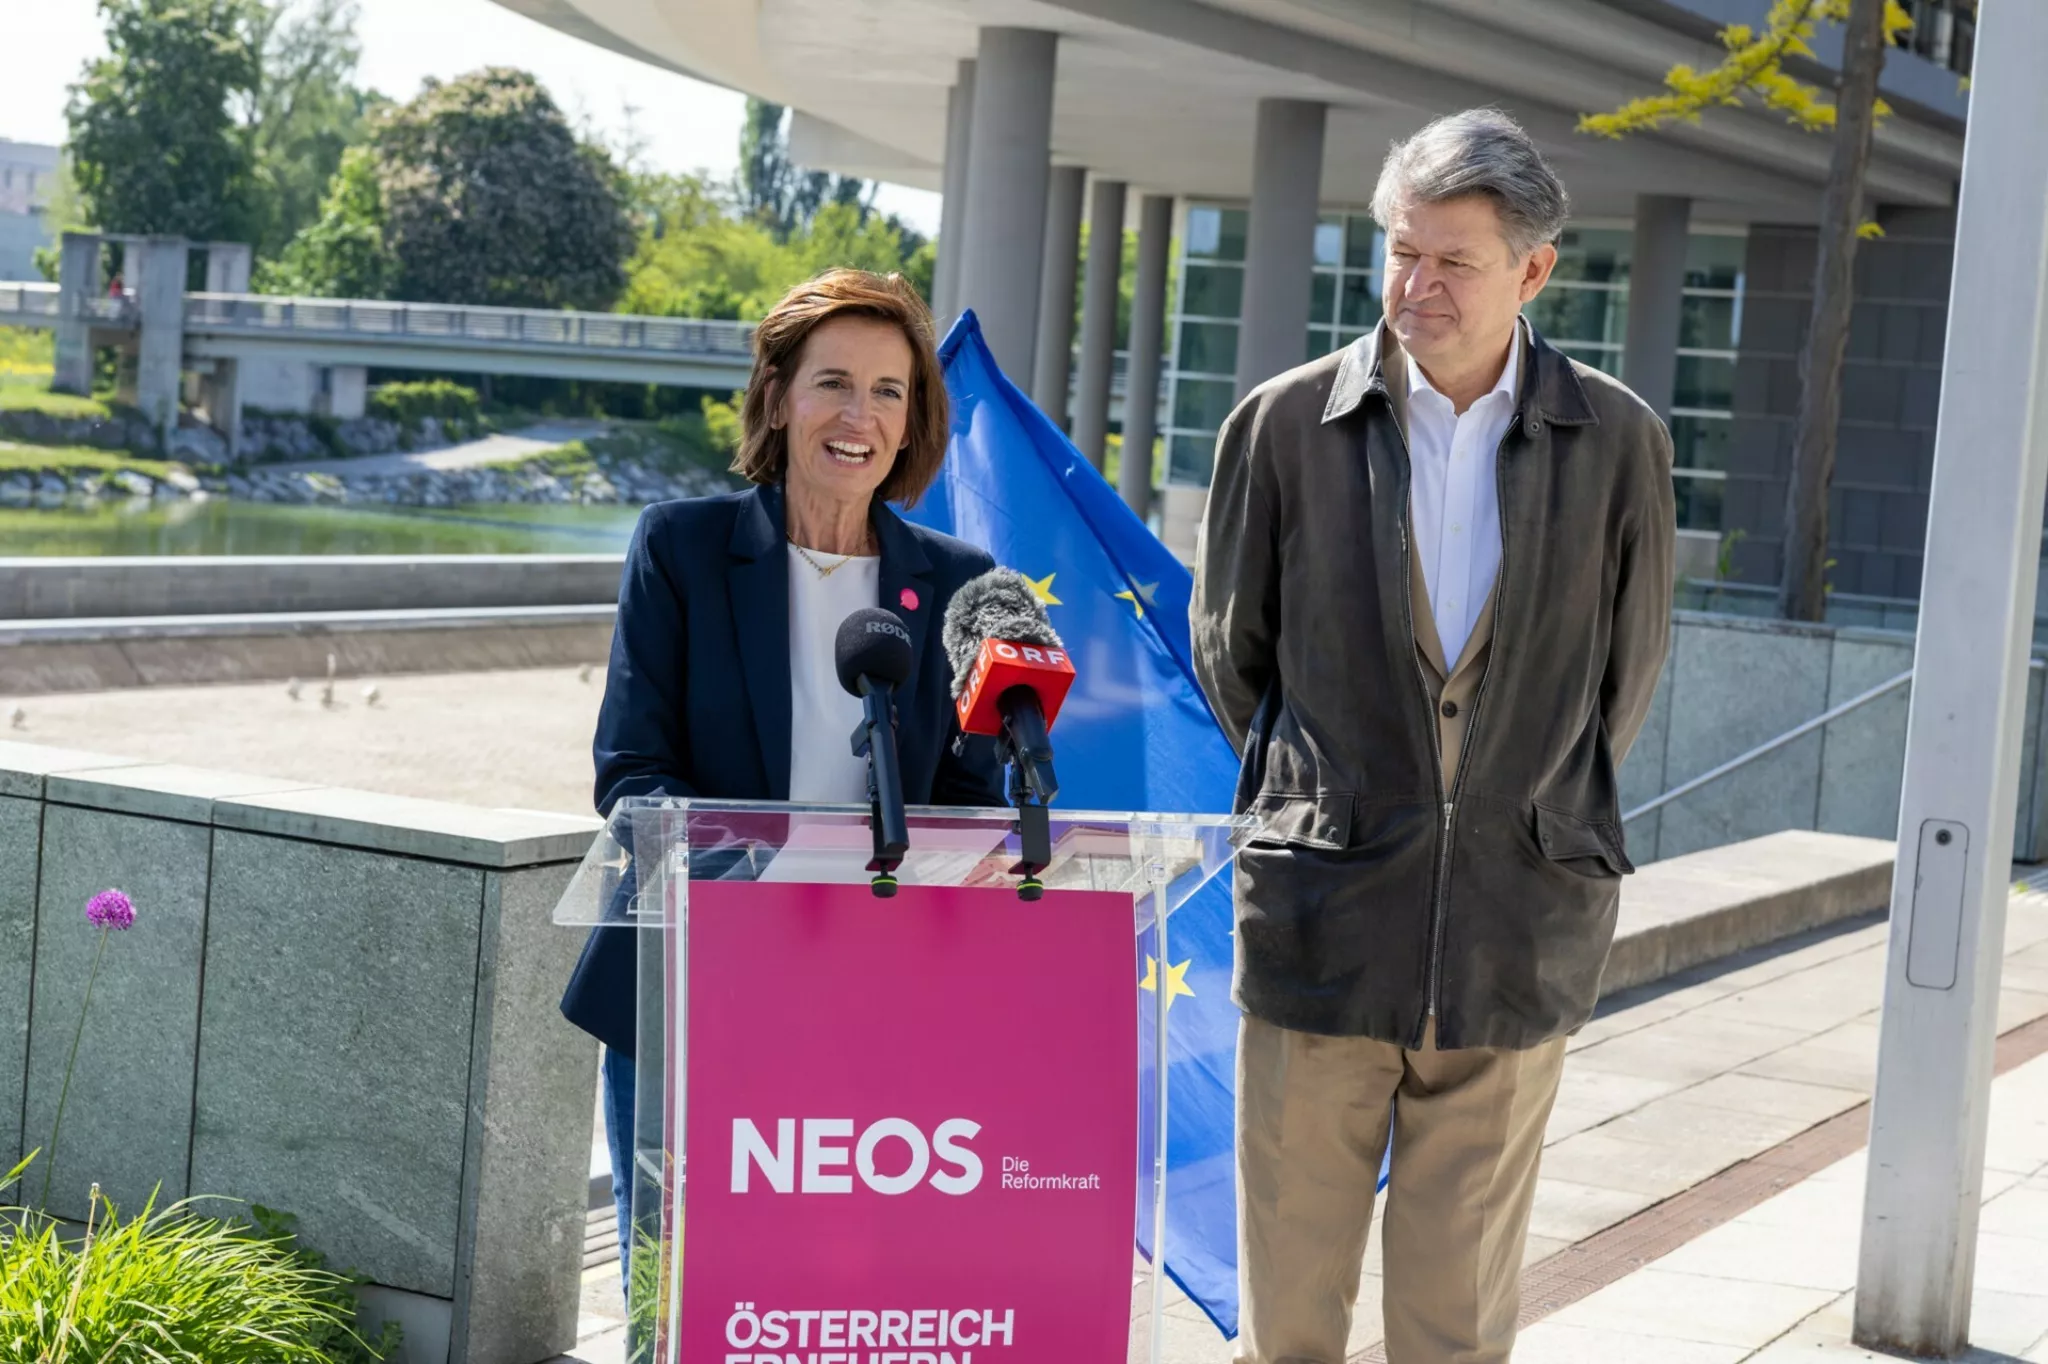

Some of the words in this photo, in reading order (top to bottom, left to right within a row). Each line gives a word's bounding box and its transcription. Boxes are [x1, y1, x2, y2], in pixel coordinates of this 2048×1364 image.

[995, 643, 1065, 665] ORF
[961, 646, 987, 714] ORF
[730, 1117, 984, 1195] NEOS
[1001, 1156, 1030, 1172] Die
[1001, 1173, 1101, 1190] Reformkraft
[725, 1302, 1015, 1349] ÖSTERREICH
